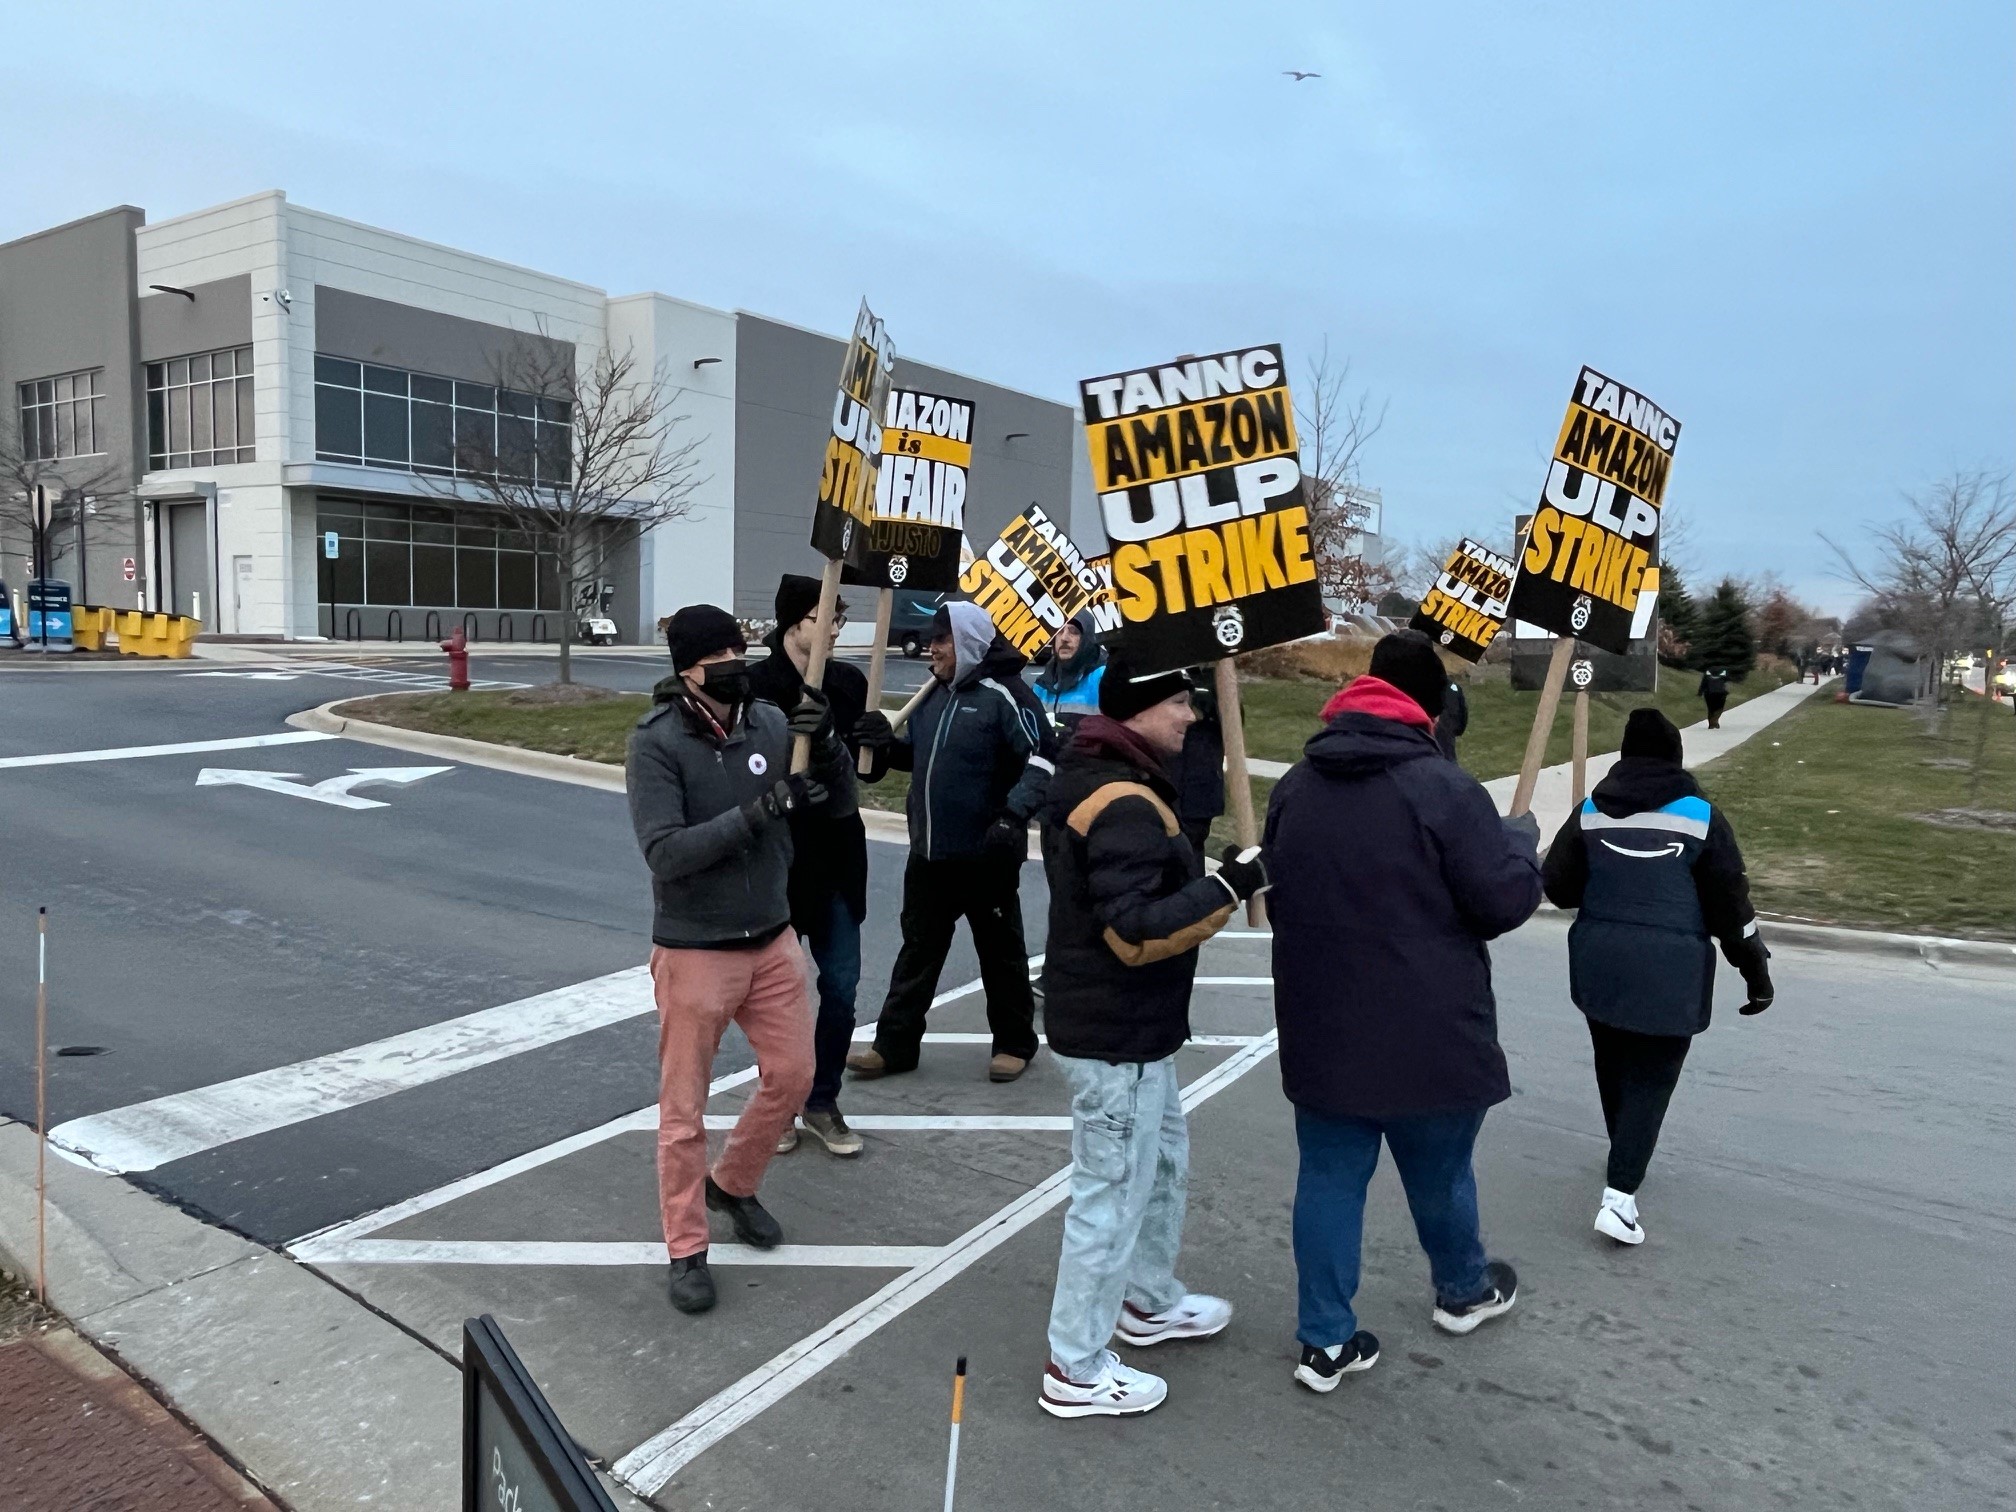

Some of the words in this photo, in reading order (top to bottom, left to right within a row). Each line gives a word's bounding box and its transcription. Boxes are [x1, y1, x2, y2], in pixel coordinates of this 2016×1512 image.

[833, 388, 882, 455] ULP
[887, 391, 970, 442] AZON
[1087, 350, 1279, 418] TANNC
[1581, 371, 1677, 450] TANNC
[898, 432, 921, 454] is
[1105, 391, 1290, 487] AMAZON
[1560, 409, 1670, 506] AMAZON
[873, 455, 966, 530] NFAIR
[1102, 458, 1301, 541] ULP
[1545, 460, 1658, 540] ULP
[871, 523, 941, 558] NJUSTO
[1005, 524, 1085, 614] AMAZON
[1028, 505, 1098, 591] TANNC
[1113, 507, 1316, 622] STRIKE
[1448, 554, 1511, 598] AMAZO
[1464, 540, 1516, 579] TANN
[1524, 508, 1650, 612] STRIKE
[959, 559, 1051, 661] STRIKE
[986, 539, 1065, 629] ULP
[1420, 589, 1502, 648] STRIKE
[1436, 571, 1508, 619] ULP
